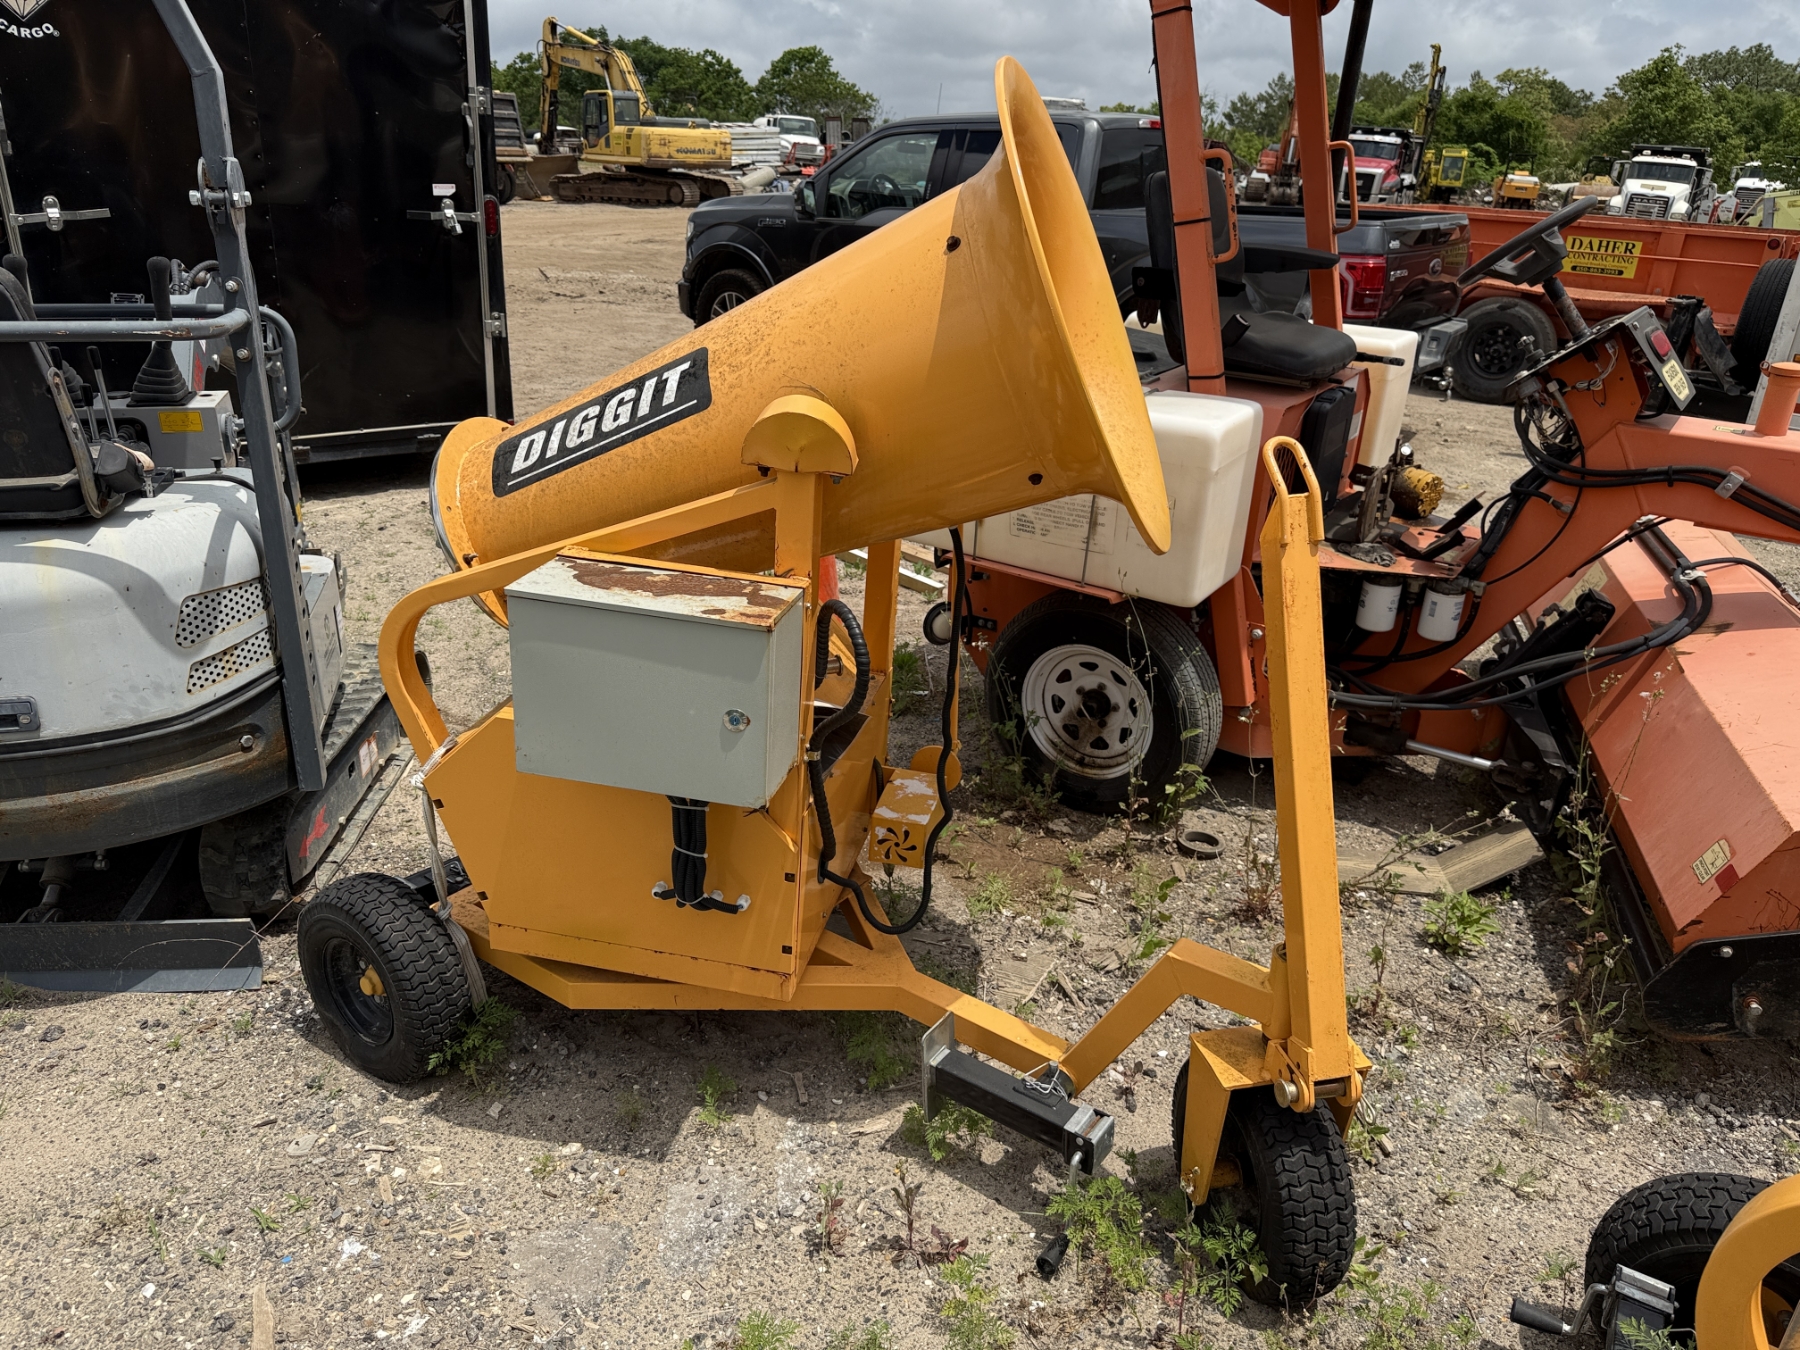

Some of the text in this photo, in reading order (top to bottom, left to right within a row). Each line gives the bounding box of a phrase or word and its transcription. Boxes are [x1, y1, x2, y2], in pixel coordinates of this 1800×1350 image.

[0, 18, 54, 39] CARGO
[676, 147, 716, 155] KOMATSU
[1570, 237, 1635, 255] DAHER
[1567, 251, 1634, 265] CONTRACTING
[511, 361, 691, 474] DIGGIT
